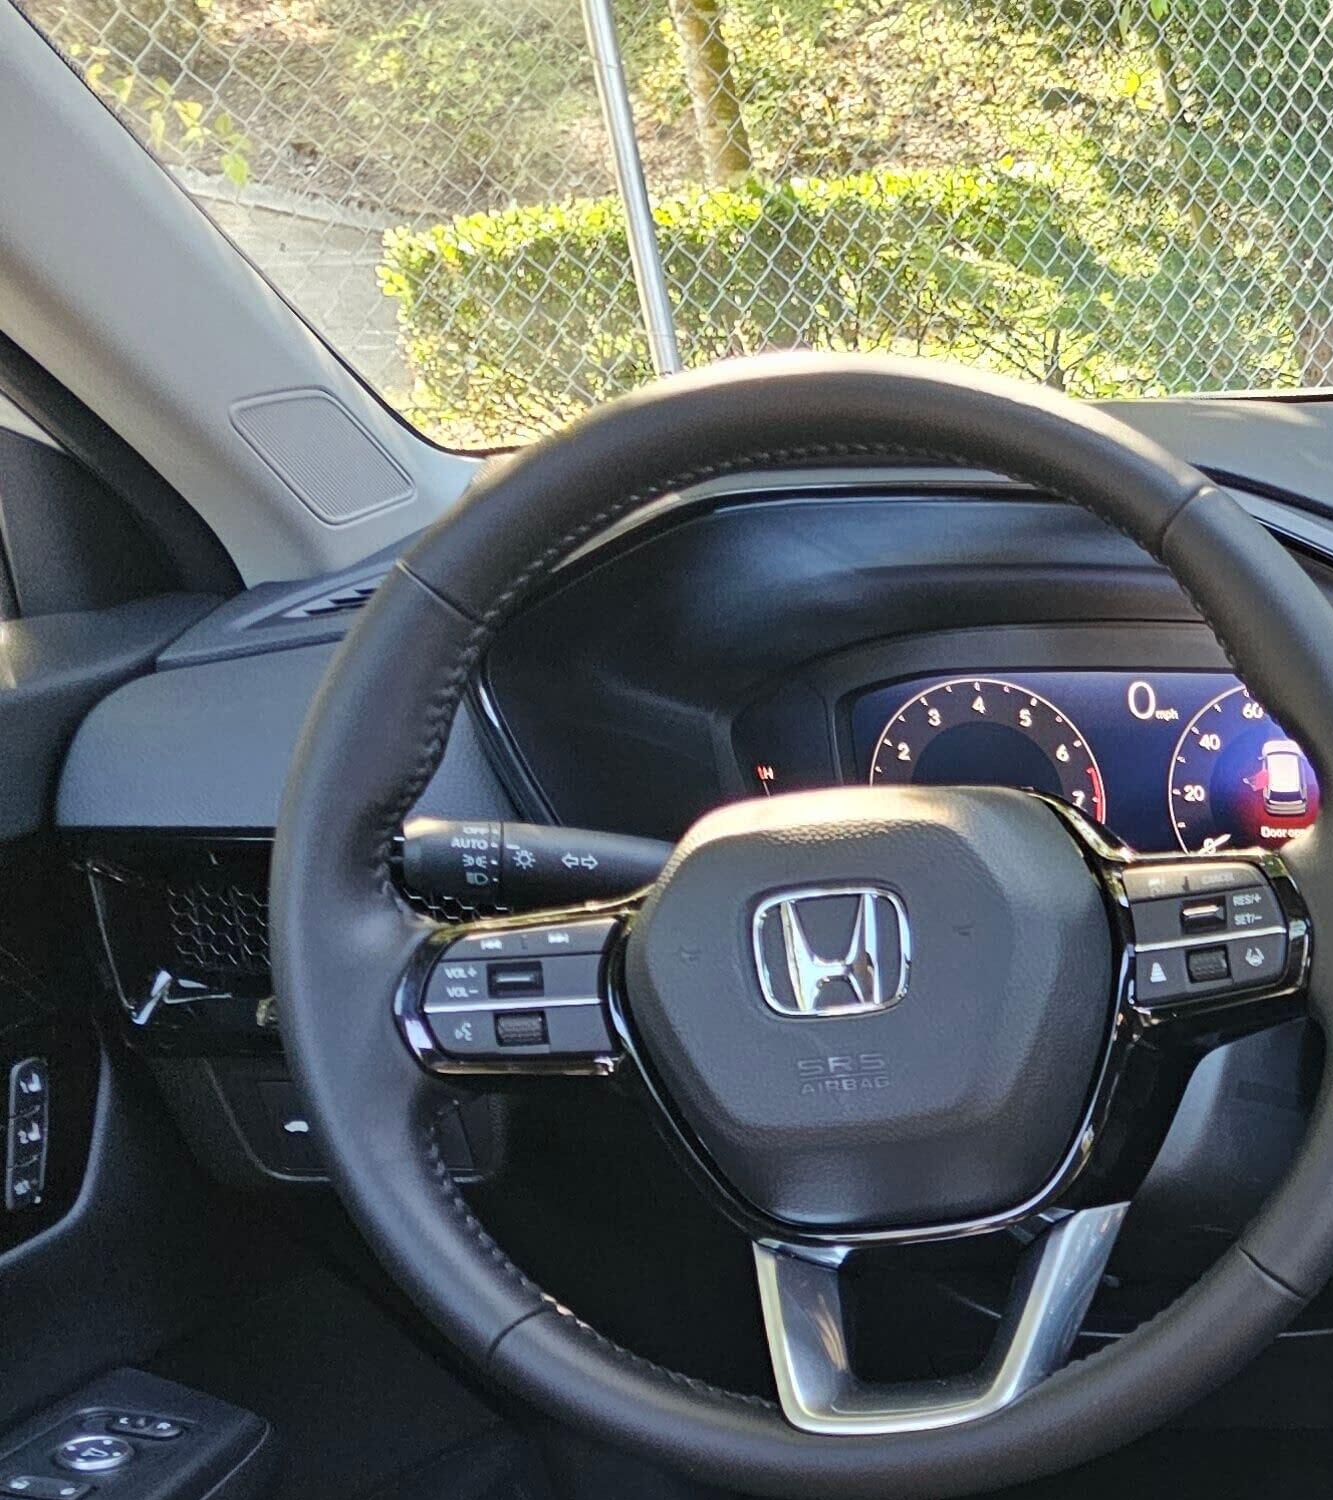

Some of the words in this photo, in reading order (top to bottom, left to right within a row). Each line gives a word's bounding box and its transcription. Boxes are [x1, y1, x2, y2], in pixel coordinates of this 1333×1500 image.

[971, 696, 986, 714] 4
[1128, 681, 1155, 719] 0
[1155, 708, 1178, 721] mph
[928, 708, 941, 727] 3
[1019, 708, 1033, 727] 5
[1242, 703, 1264, 718] 60
[1199, 734, 1221, 750] 40
[898, 742, 911, 761] 2
[1056, 744, 1070, 762] 6
[1184, 785, 1205, 802] 20
[1261, 826, 1286, 838] Door
[451, 837, 489, 850] AUTO
[797, 1053, 886, 1076] SRS
[801, 1076, 890, 1095] AIRBAG
